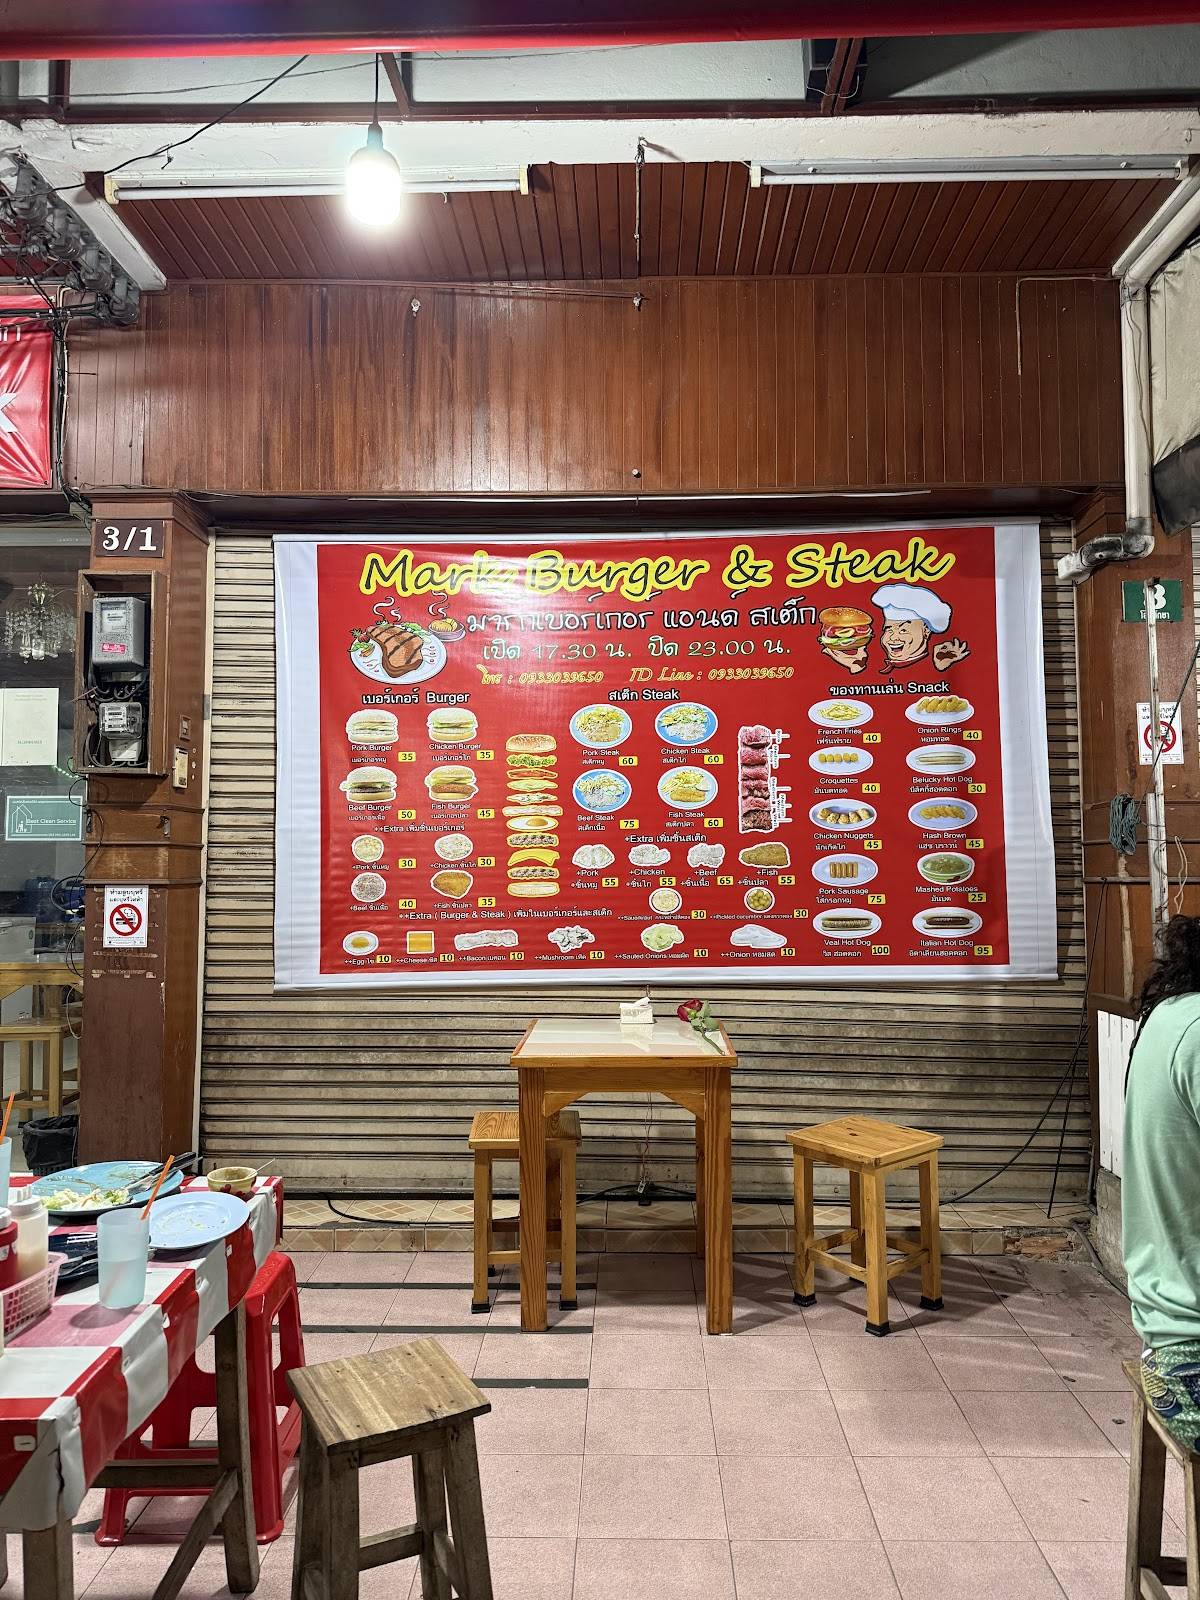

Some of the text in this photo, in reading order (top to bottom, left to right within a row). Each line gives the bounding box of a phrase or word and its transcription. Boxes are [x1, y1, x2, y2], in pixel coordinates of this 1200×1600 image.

[102, 526, 157, 551] 3/1
[361, 541, 953, 599] Mark Burger & Steak
[663, 588, 747, 628] แอนด์
[749, 596, 817, 626] สเต็ก
[483, 635, 791, 660] เปิด 17.30 น. ปิด 23.00 น.
[518, 671, 604, 684] 0933039650
[657, 667, 694, 681] Line
[707, 667, 795, 680] 0933039650
[829, 679, 950, 696] ของทานเล่น Snack
[362, 688, 470, 704] เบอร์เกอร์ Burger
[608, 688, 680, 701] สเต็ก Steak
[844, 727, 863, 735] Fries
[940, 726, 962, 734] Rings
[865, 734, 878, 742] 40
[966, 731, 979, 739] 40
[370, 744, 393, 752] Burger
[459, 743, 481, 751] Burger
[401, 753, 413, 761] 35
[479, 751, 491, 759] 35
[707, 755, 720, 763] 60
[621, 757, 634, 765] 60
[819, 777, 859, 785] Croquettes
[957, 775, 973, 784] Dog
[864, 784, 877, 792] 40
[970, 784, 983, 792] 30
[367, 804, 392, 812] Burger
[447, 803, 471, 811] Burger
[401, 811, 413, 819] 50
[479, 810, 491, 818] 45
[623, 820, 635, 828] 75
[707, 819, 720, 827] 60
[625, 835, 654, 843] +Extra
[843, 832, 874, 840] Nuggets
[866, 840, 879, 849] 45
[968, 839, 981, 848] 45
[401, 859, 413, 868] 30
[480, 858, 492, 866] 30
[576, 869, 599, 877] +Pork
[756, 868, 778, 876] +Fish
[603, 878, 616, 887] 55
[661, 877, 673, 886] 55
[719, 876, 731, 885] 65
[780, 876, 793, 885] 55
[837, 888, 869, 896] Sausage
[946, 885, 979, 893] Potatoes
[870, 895, 882, 903] 75
[971, 893, 984, 902] 25
[401, 900, 413, 908] 40
[481, 898, 493, 906] 35
[399, 911, 432, 920] ++Extra
[440, 911, 469, 921] Burger
[471, 910, 479, 919] &
[480, 910, 506, 919] Steak
[692, 910, 705, 919] 30
[795, 909, 807, 918] 30
[855, 938, 871, 947] Dog
[958, 939, 974, 947] Dog
[695, 949, 707, 957] 10
[782, 948, 794, 956] 10
[872, 946, 889, 955] 100
[977, 946, 989, 955] 95
[379, 955, 390, 963] 10
[441, 954, 453, 962] 10
[511, 952, 523, 960] 10
[591, 951, 603, 959] 10
